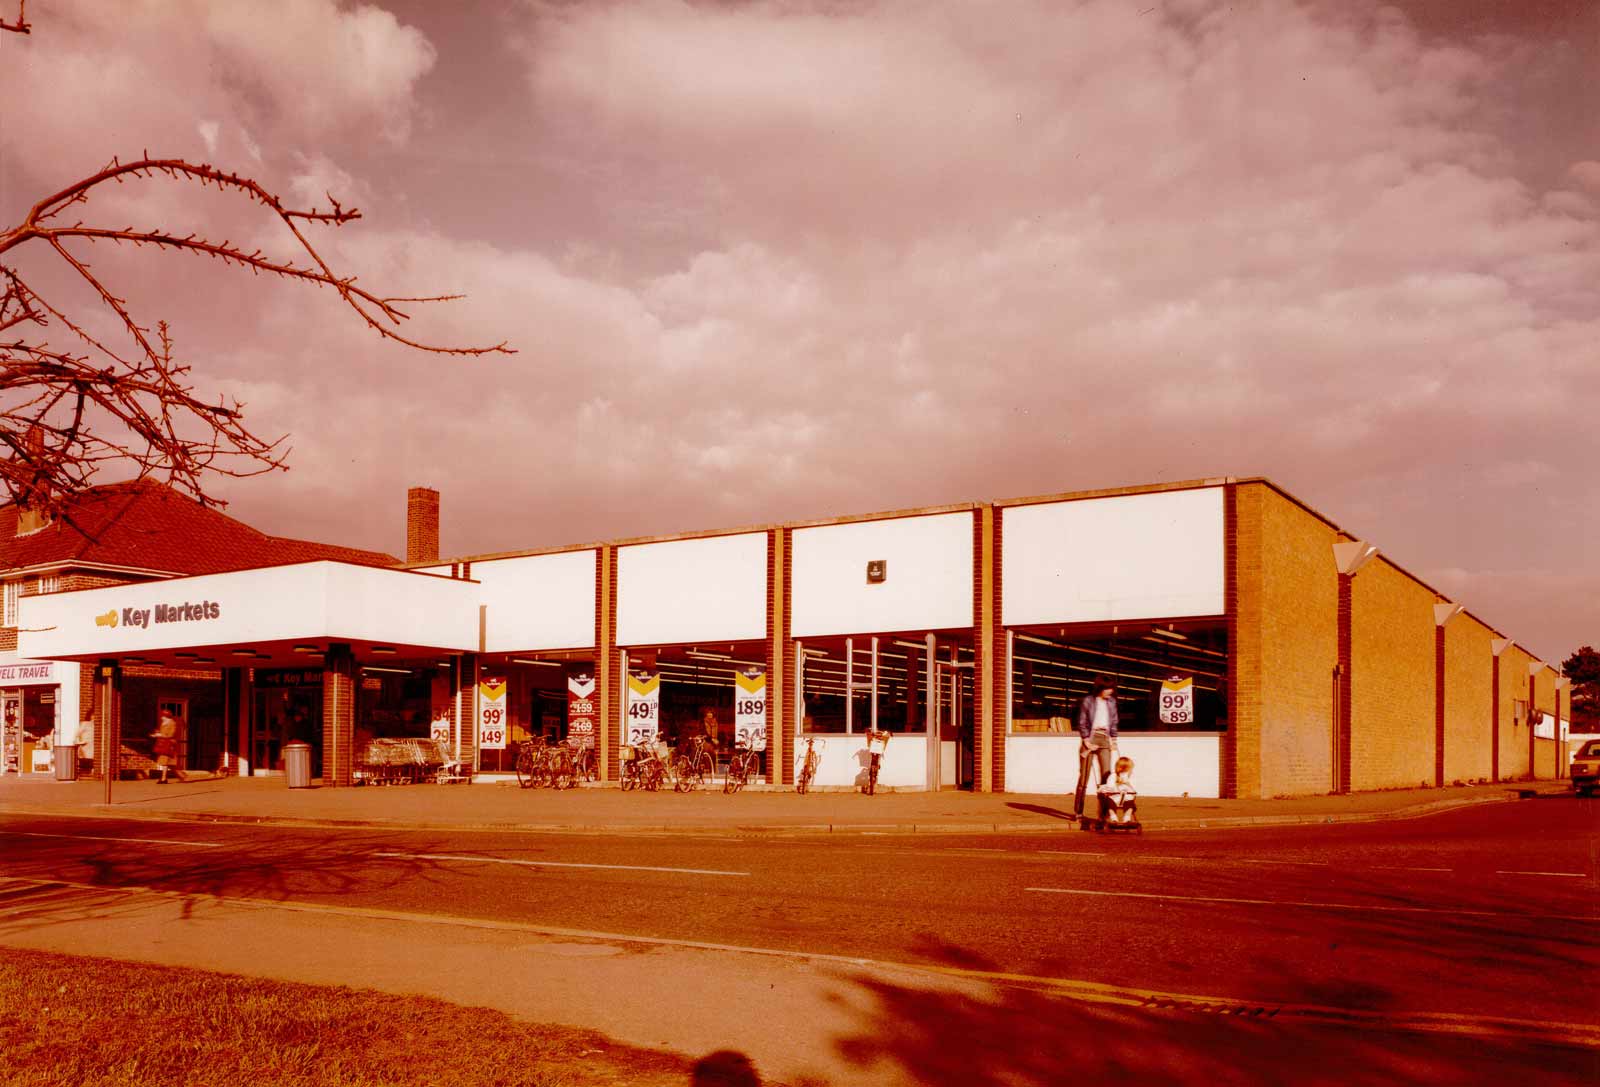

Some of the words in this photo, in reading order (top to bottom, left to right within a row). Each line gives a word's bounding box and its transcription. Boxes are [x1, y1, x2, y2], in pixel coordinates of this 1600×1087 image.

[122, 607, 151, 629] Key
[155, 600, 220, 623] Markets
[0, 668, 16, 679] ELL
[18, 666, 49, 678] TRAVEL
